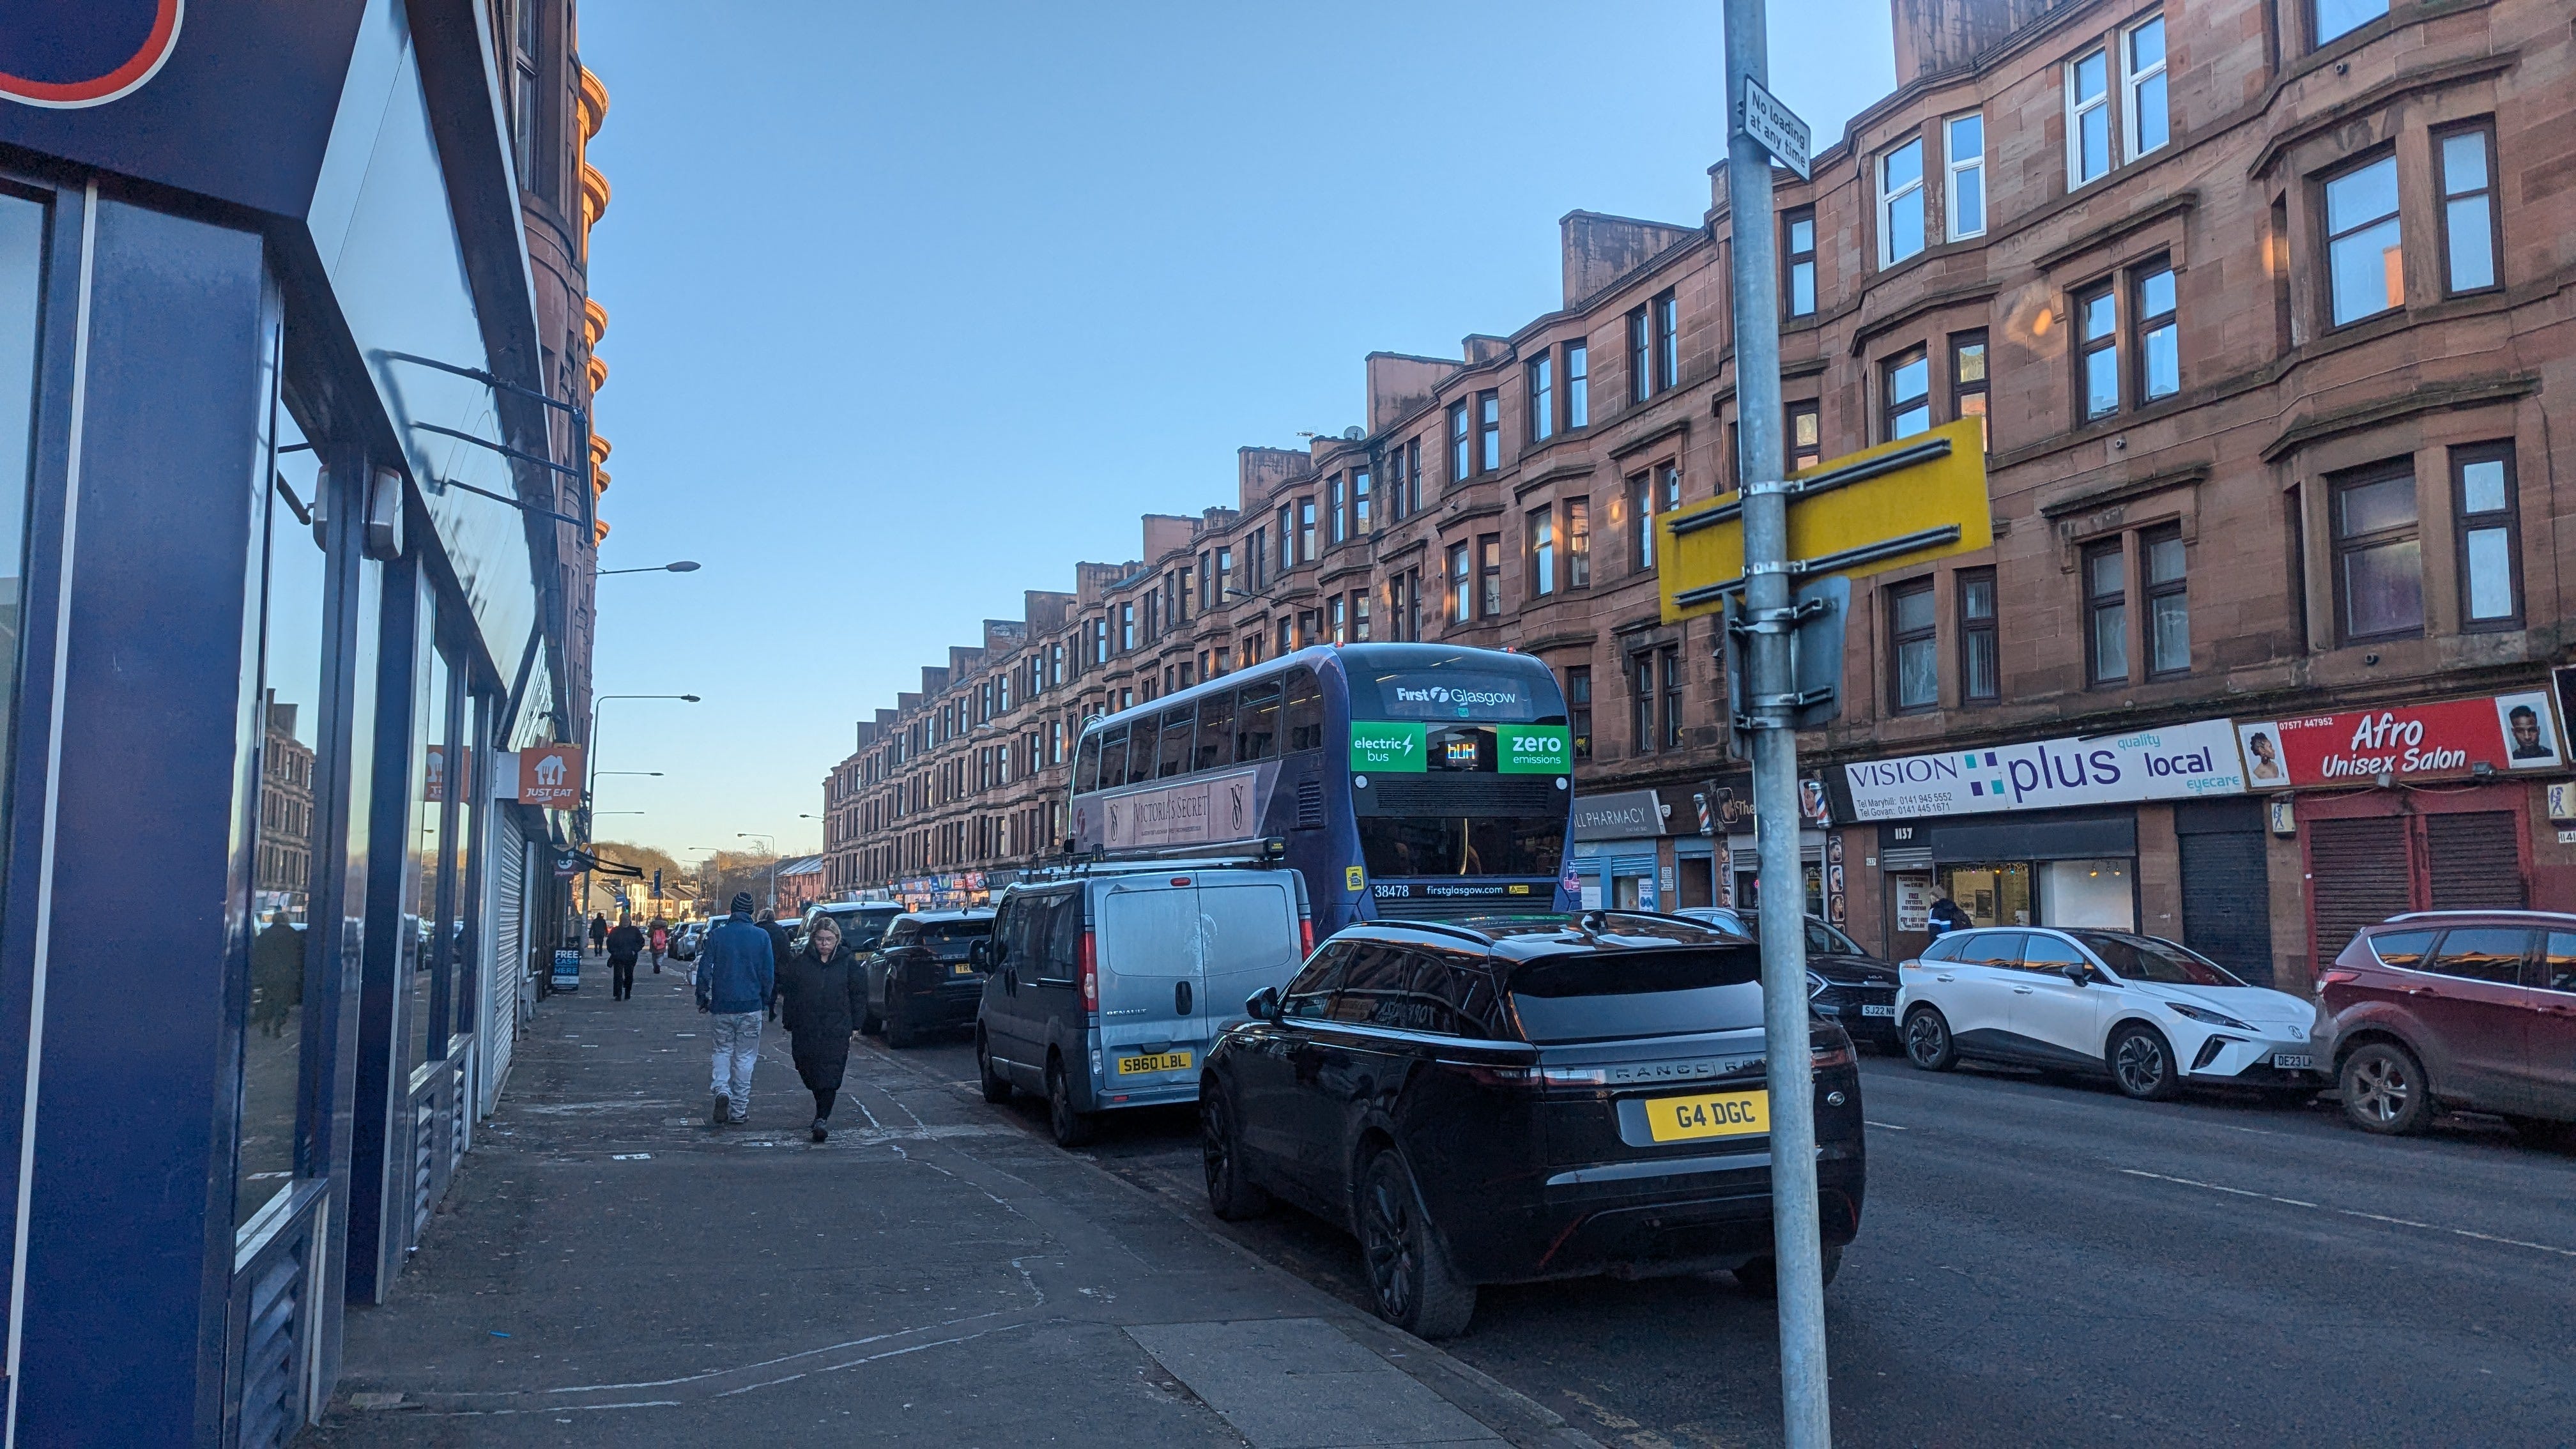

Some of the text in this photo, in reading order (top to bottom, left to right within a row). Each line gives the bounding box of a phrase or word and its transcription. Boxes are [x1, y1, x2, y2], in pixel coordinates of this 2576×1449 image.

[1752, 90, 1805, 150] No loading
[1750, 114, 1806, 169] at any time
[1396, 687, 1515, 706] First Glasgow
[2279, 717, 2333, 731] 07577 447952
[2351, 711, 2424, 751] Afro
[1354, 736, 1402, 749] electric
[1512, 736, 1561, 752] zero
[2117, 733, 2161, 751] quality
[1367, 750, 1390, 762] bus
[1513, 754, 1561, 765] emissions
[2143, 746, 2214, 778] local
[2322, 746, 2466, 778] Unisex Salon
[1850, 744, 2121, 804] VISION plus
[2186, 774, 2240, 792] eyecare
[526, 788, 573, 797] JUST EAT
[1857, 792, 1952, 809] Tel Maryhill: 0141 945 5552
[1177, 795, 1208, 819] SECRET
[1735, 799, 1755, 815] The
[1859, 802, 1951, 817] Tel Govan: 0141 445 1671
[1586, 807, 1646, 827] PHARMACY
[1894, 827, 1913, 840] 1137
[1374, 885, 1409, 898] 38478
[1426, 885, 1503, 896] firstglasgow.com
[555, 949, 579, 958] FREE
[1106, 1008, 1147, 1017] RENAULT
[1865, 1006, 1885, 1015] SJ22
[1123, 1055, 1186, 1072] SB60 LBL
[2278, 1055, 2301, 1066] DE23
[1616, 1063, 1708, 1079] RANGE
[1675, 1100, 1756, 1129] G4 DGC
